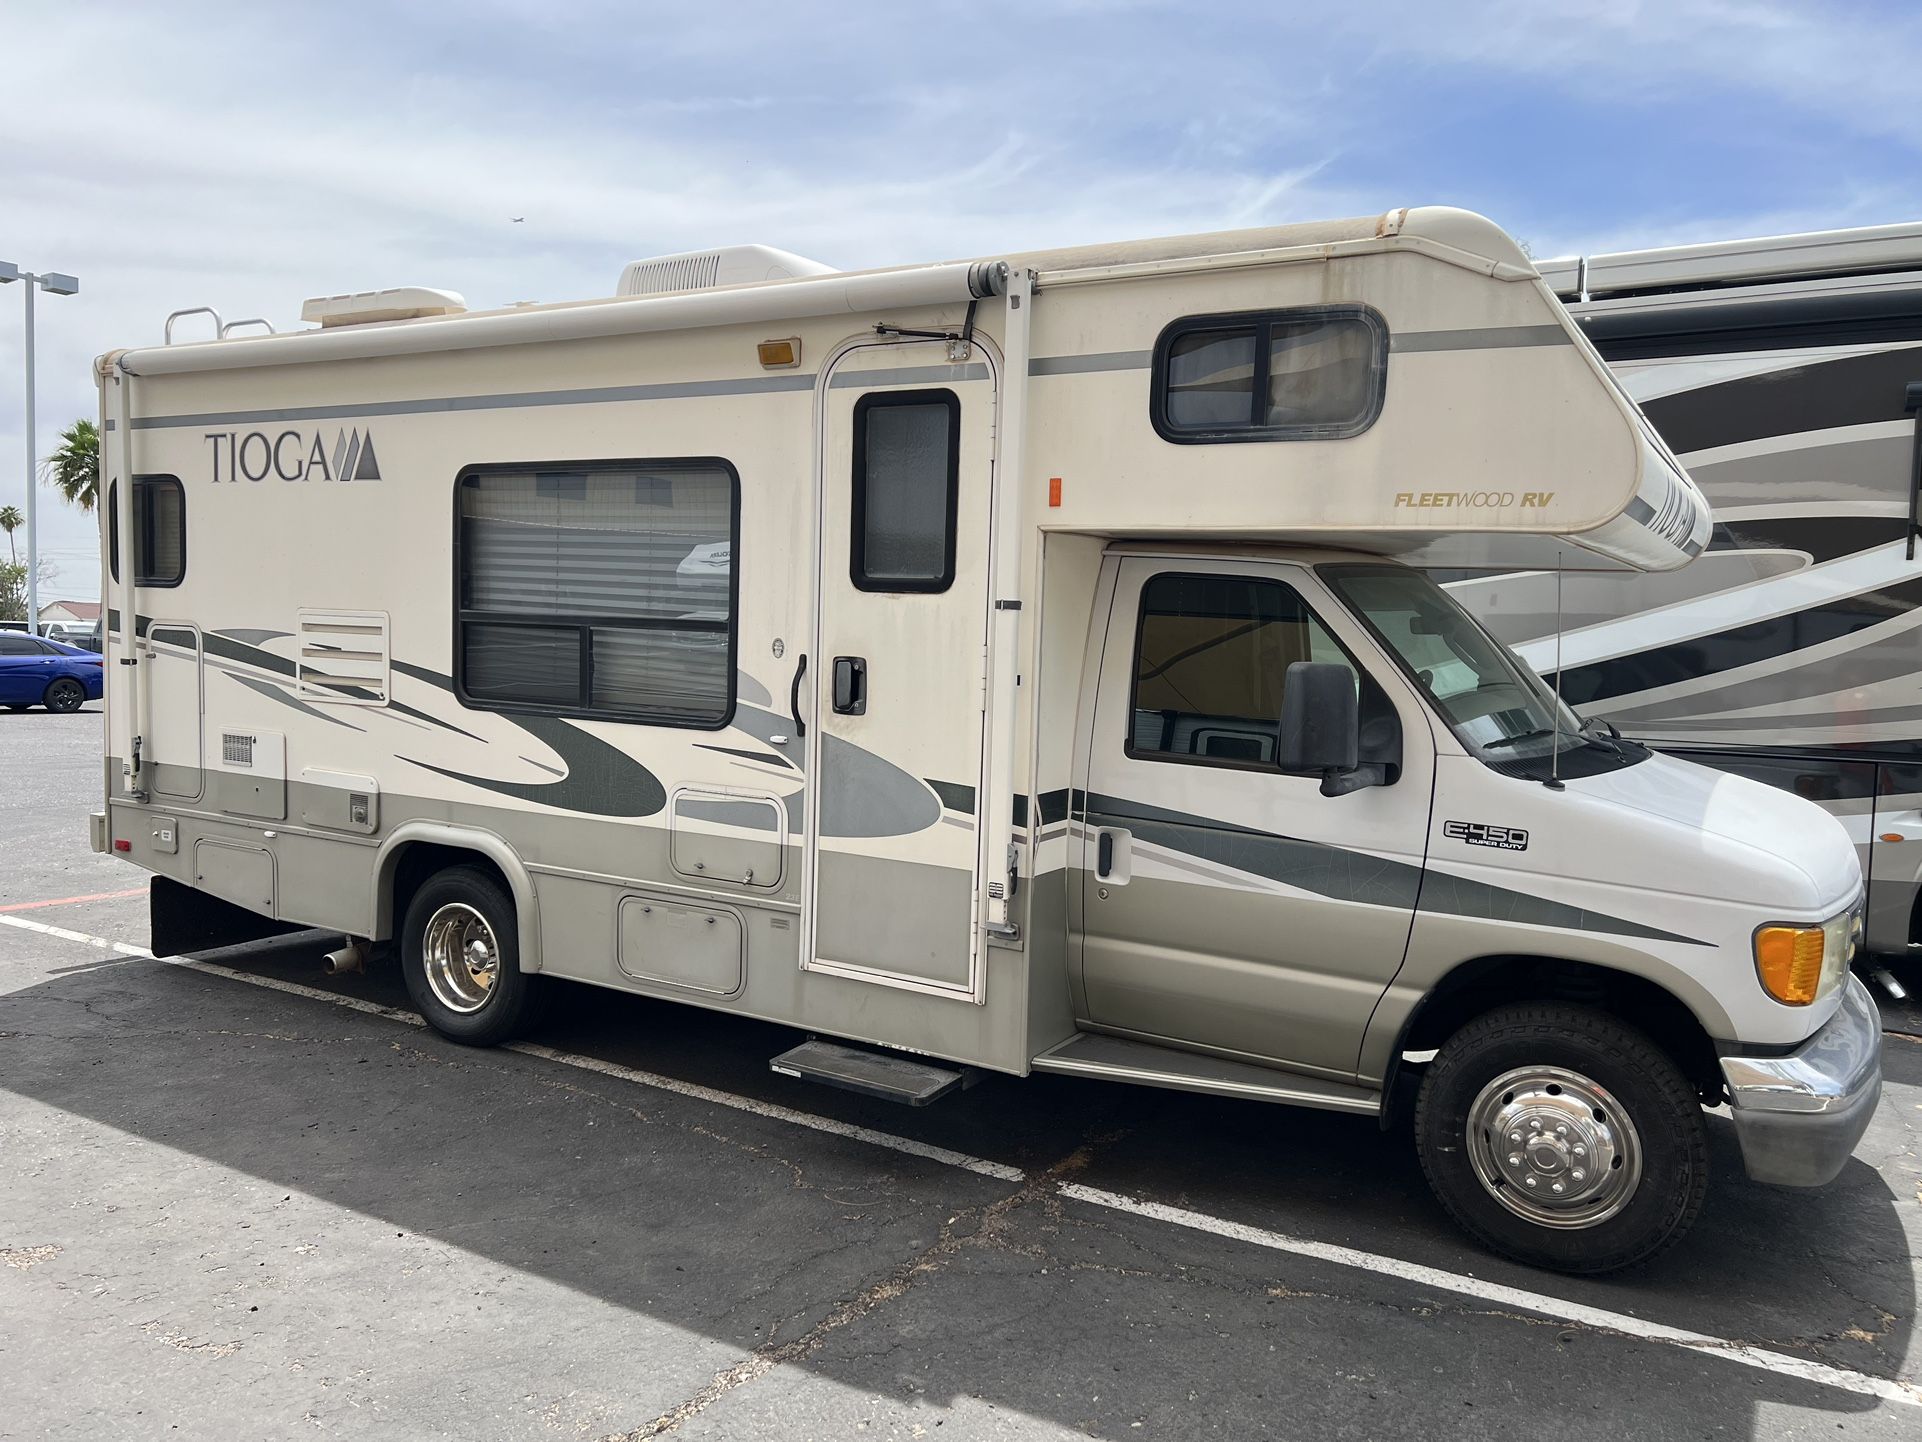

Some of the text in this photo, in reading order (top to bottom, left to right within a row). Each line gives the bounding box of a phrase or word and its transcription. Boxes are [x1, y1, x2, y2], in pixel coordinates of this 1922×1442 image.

[204, 428, 332, 482] TIOGA
[1394, 491, 1555, 508] FLEETWOOD RV
[1468, 838, 1524, 850] SUPER DUTY
